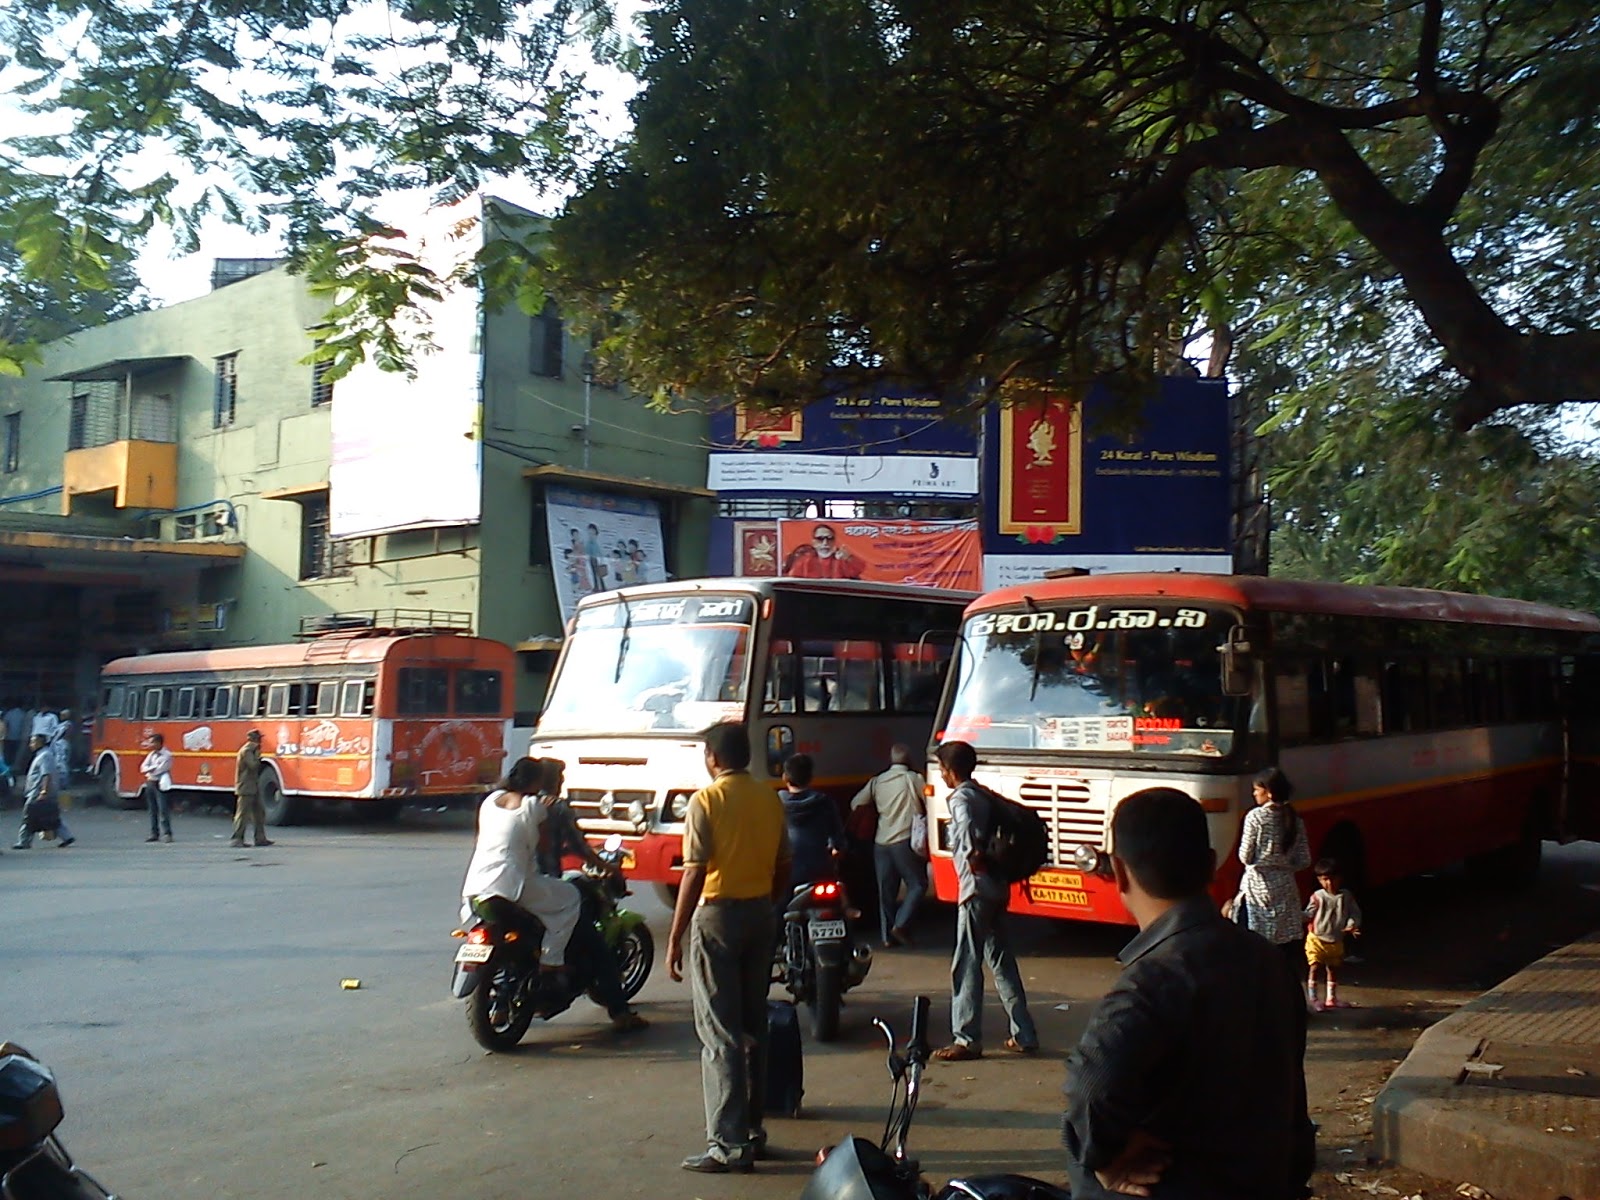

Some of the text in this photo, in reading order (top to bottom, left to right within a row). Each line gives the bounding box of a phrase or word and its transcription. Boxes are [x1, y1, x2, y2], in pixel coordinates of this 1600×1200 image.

[835, 397, 848, 407] 24
[880, 397, 902, 407] Pure
[902, 397, 941, 407] Wisdom
[1100, 450, 1114, 460] 24
[1115, 450, 1142, 460] Karat
[1150, 451, 1174, 461] Pure
[1175, 451, 1217, 462] Wisdom
[1135, 717, 1181, 732] POONA
